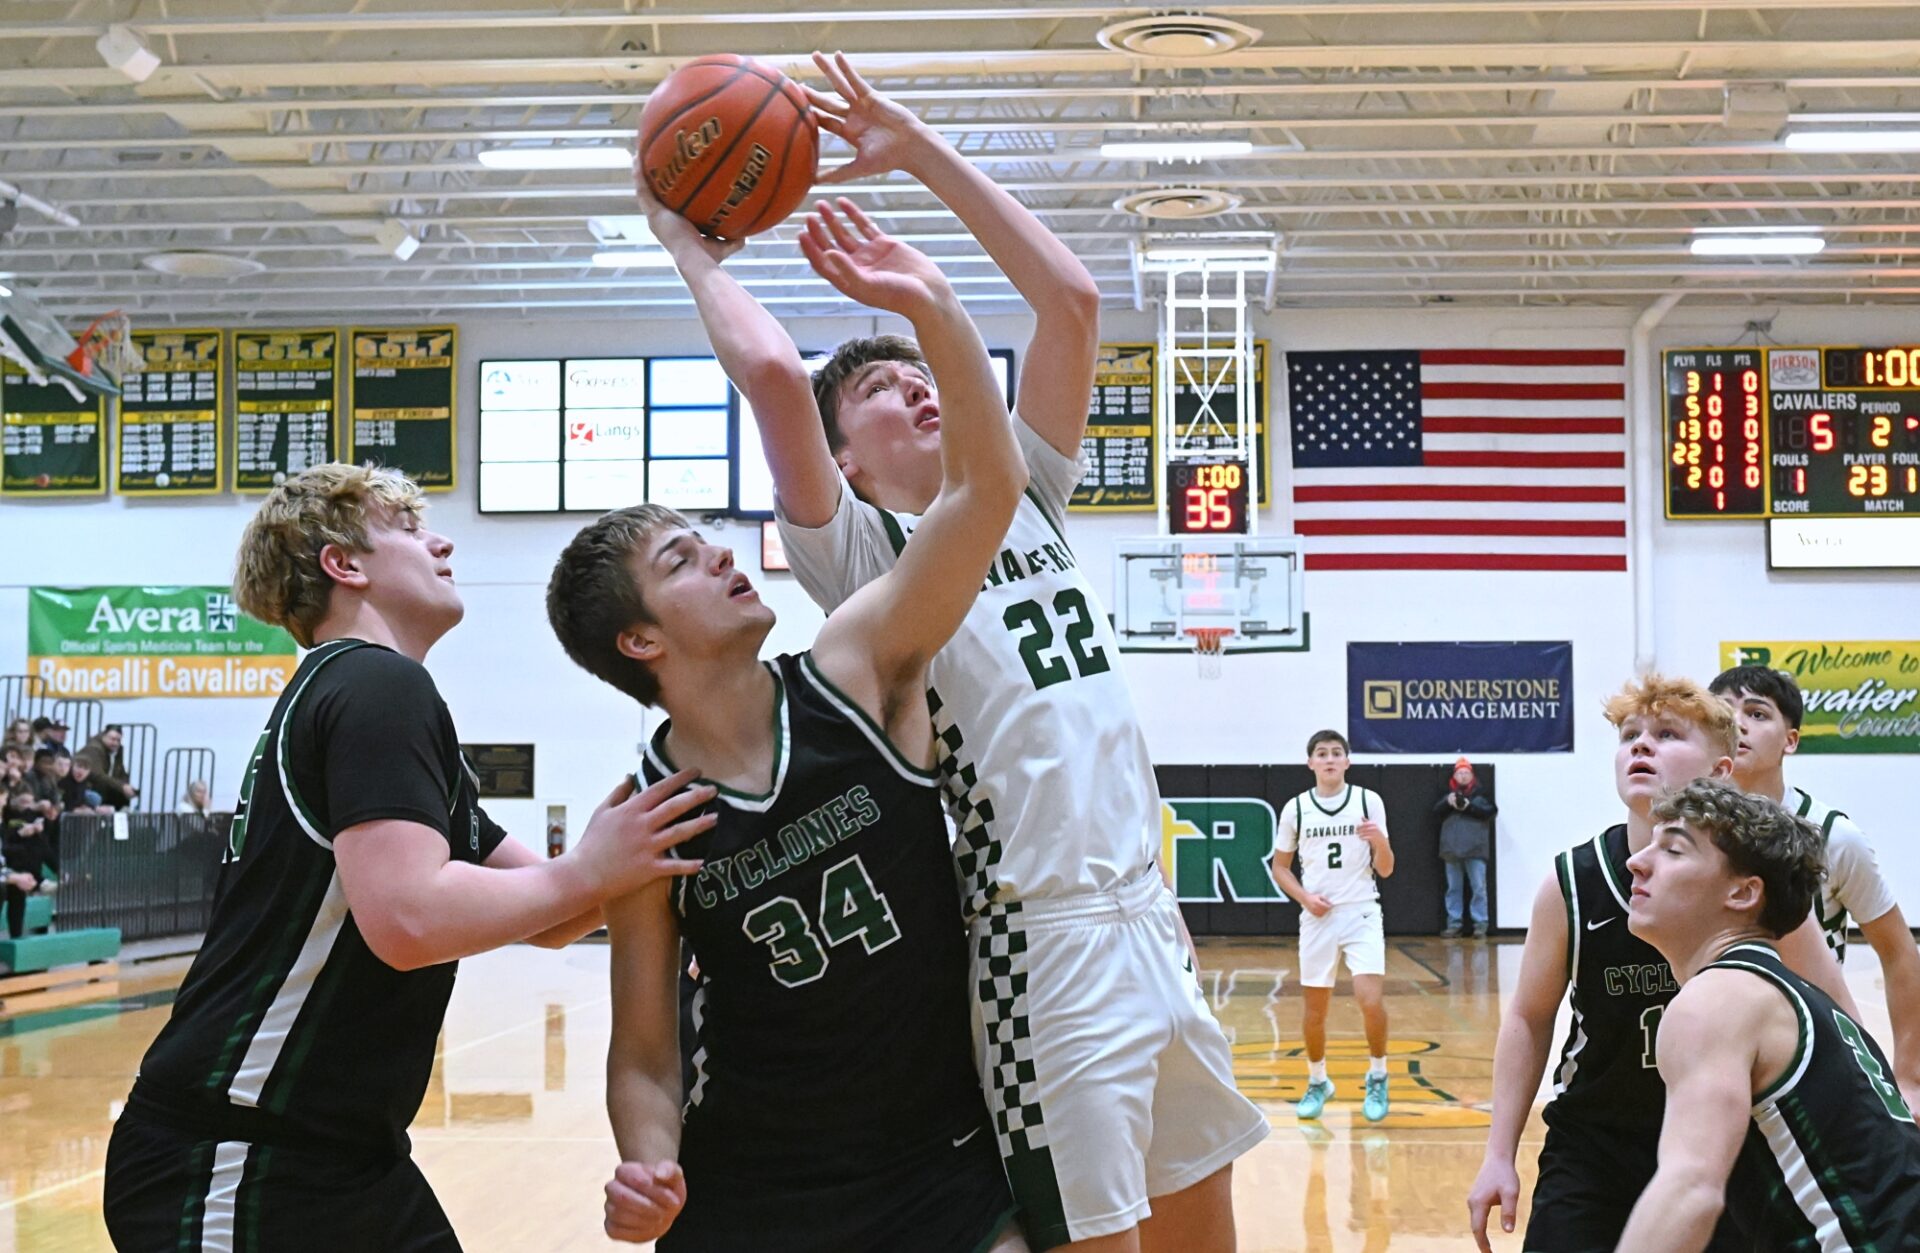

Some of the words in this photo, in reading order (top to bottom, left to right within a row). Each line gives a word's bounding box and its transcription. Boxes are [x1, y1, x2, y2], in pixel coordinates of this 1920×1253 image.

[1673, 355, 1696, 367] PLYR
[1706, 355, 1722, 367] FLS
[1734, 355, 1751, 367] PTS
[1772, 355, 1816, 369] PIERSON
[1687, 371, 1700, 394] 3
[1714, 372, 1722, 392] 1
[1743, 370, 1757, 393] 0
[1686, 395, 1700, 417] 5
[1707, 395, 1722, 417] 0
[1745, 395, 1758, 417] 3
[1773, 392, 1857, 411] CAVALIERS
[1861, 402, 1901, 414] PERIOD
[1679, 418, 1701, 441] 13
[1708, 418, 1723, 441] 0
[1744, 418, 1759, 440] 0
[1810, 414, 1833, 451] 5
[1872, 416, 1891, 447] 2
[1673, 442, 1701, 465] 22
[1715, 444, 1723, 463] 1
[1745, 442, 1759, 464] 2
[1773, 454, 1809, 466] FOULS
[1843, 453, 1886, 465] PLAYER
[1197, 465, 1240, 489] 1:00
[1687, 466, 1702, 489] 2
[1709, 465, 1724, 488] 0
[1745, 465, 1760, 488] 0
[1796, 468, 1805, 494] 1
[1848, 465, 1887, 496] 23
[1908, 467, 1916, 494] 1
[1186, 489, 1231, 528] 35
[1716, 491, 1724, 510] 1
[1773, 500, 1809, 512] SCORE
[1864, 499, 1904, 512] MATCH
[86, 595, 203, 633] Avera
[60, 639, 99, 652] Official
[103, 640, 137, 654] Sports
[140, 640, 192, 652] Medicine
[195, 640, 225, 652] Team
[227, 640, 242, 652] for
[245, 640, 264, 652] the
[1002, 587, 1111, 691] 22
[1785, 644, 1893, 676] Welcome
[1899, 653, 1919, 673] to
[39, 659, 149, 692] Roncalli
[158, 659, 285, 692] Cavaliers
[1405, 679, 1560, 701] CORNERSTONE
[1406, 701, 1560, 719] MANAGEMENT
[1306, 825, 1358, 839] CAVALIER
[694, 784, 881, 909] CYCLONES
[1327, 842, 1342, 869] 2
[742, 853, 902, 989] 34
[1604, 963, 1681, 995] CYCL
